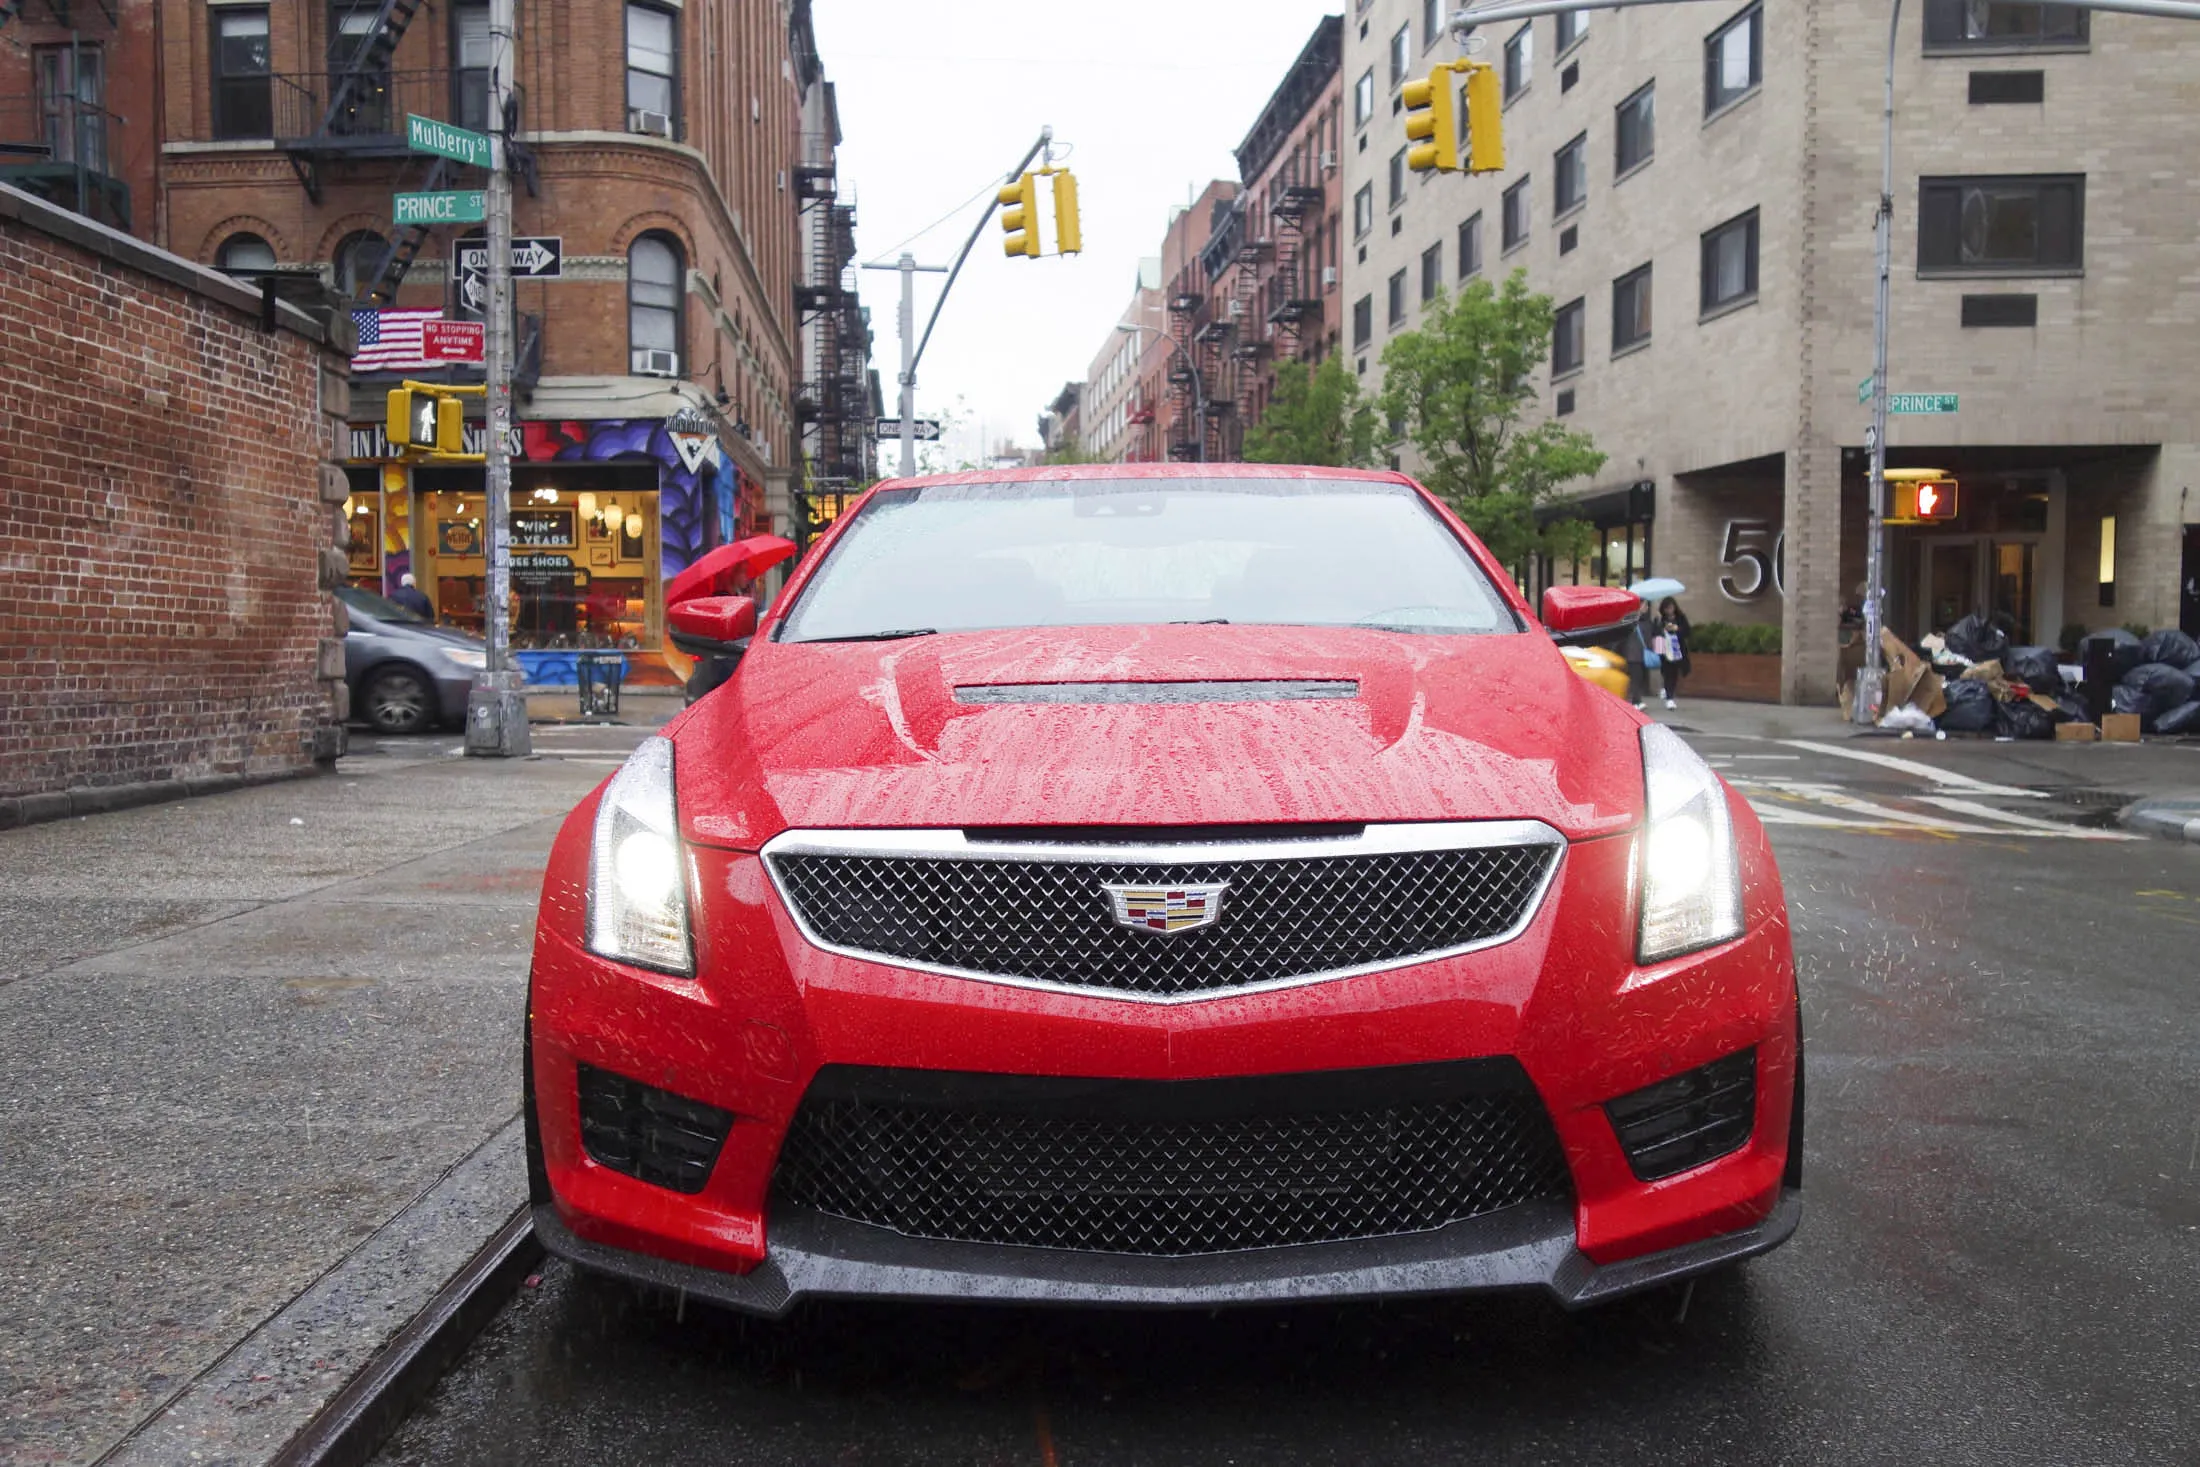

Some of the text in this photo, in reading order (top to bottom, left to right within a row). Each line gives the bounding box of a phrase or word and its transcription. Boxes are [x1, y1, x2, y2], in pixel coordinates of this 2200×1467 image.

[412, 119, 487, 163] Mulberry St
[397, 195, 481, 219] PRINCE ST
[468, 250, 544, 266] ON WAY
[425, 324, 480, 335] NO STOPPING
[432, 335, 474, 346] ANYTIME
[1891, 396, 1942, 412] PRINCE
[523, 520, 549, 533] WIN
[523, 534, 568, 546] YEARS
[531, 555, 568, 567] SHOES
[1719, 518, 1785, 603] 5
